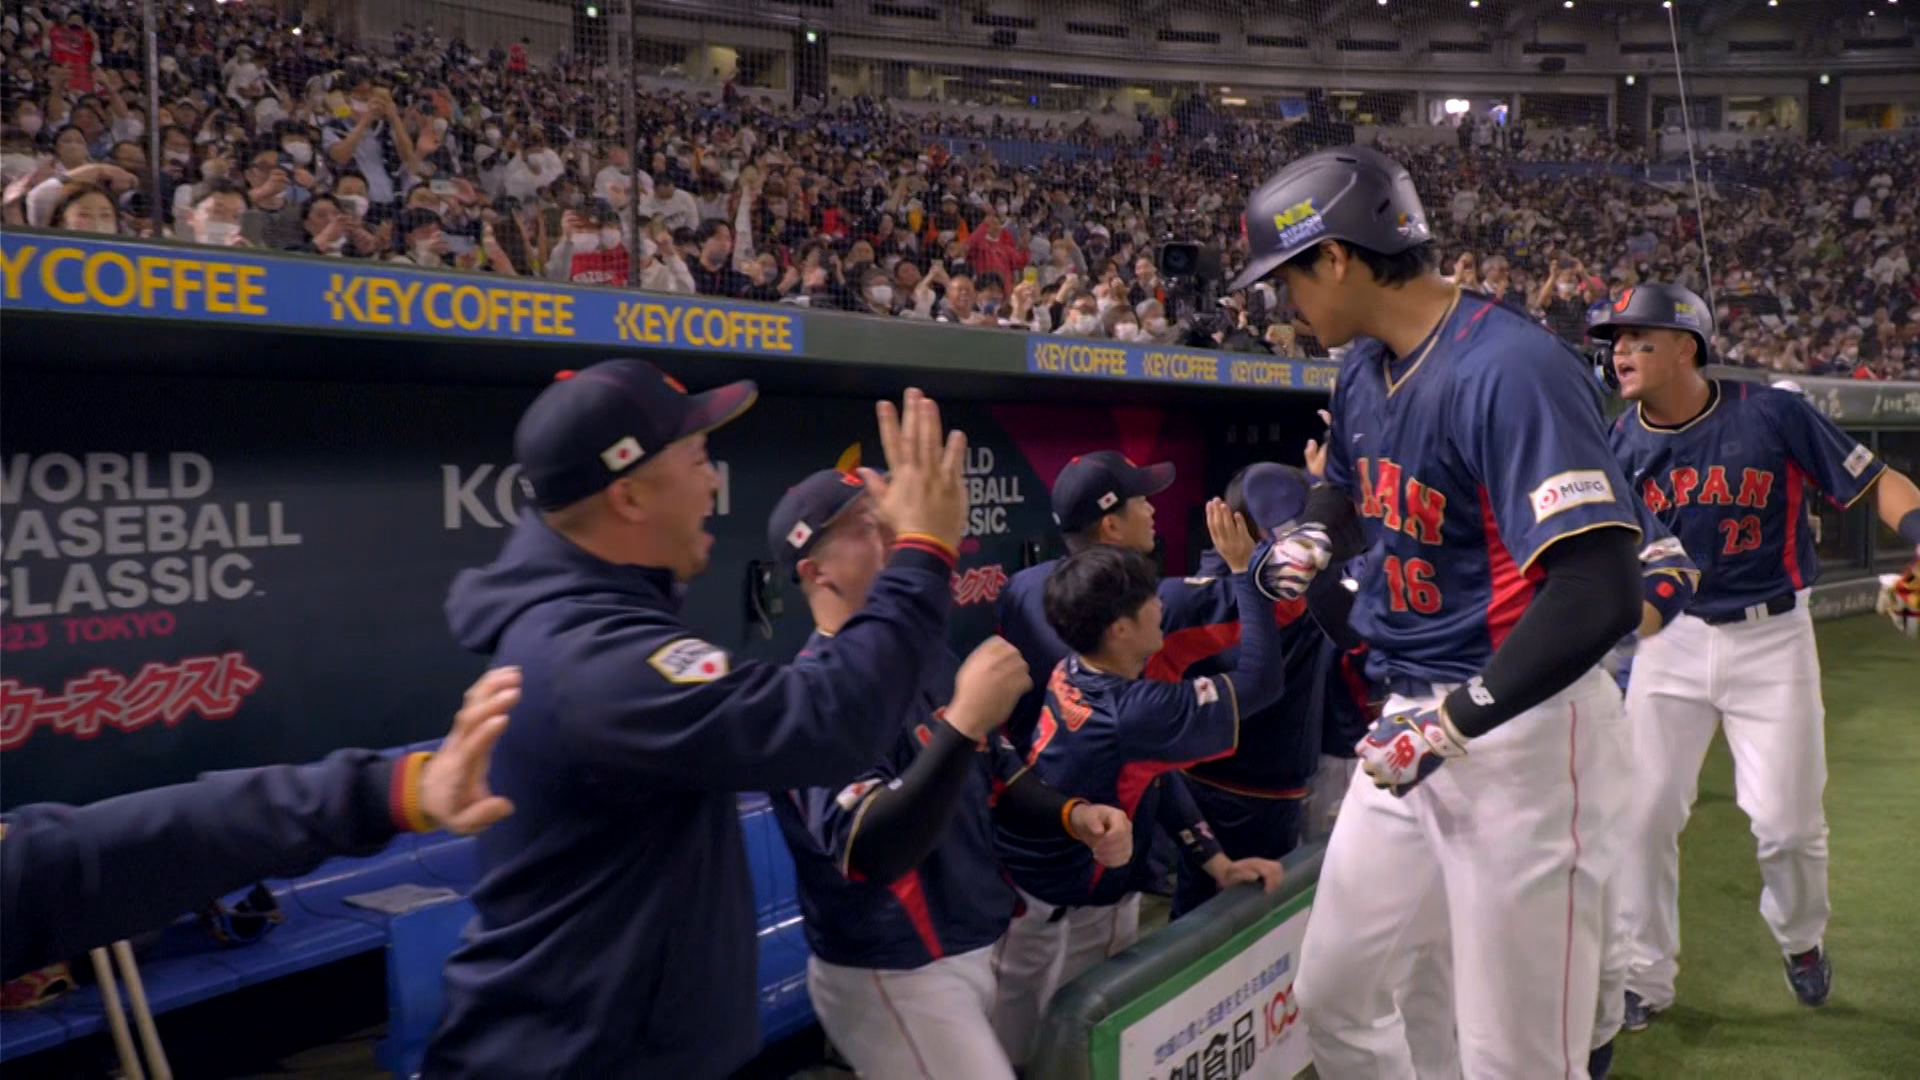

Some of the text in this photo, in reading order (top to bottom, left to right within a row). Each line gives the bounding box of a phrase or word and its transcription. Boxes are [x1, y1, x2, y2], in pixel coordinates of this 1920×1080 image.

[1560, 481, 1605, 498] MUFG
[1643, 465, 1774, 514] APAN
[0, 501, 302, 561] ASEBALL
[1719, 515, 1762, 556] 23
[0, 553, 255, 618] LASSIC
[1383, 555, 1442, 614] 16
